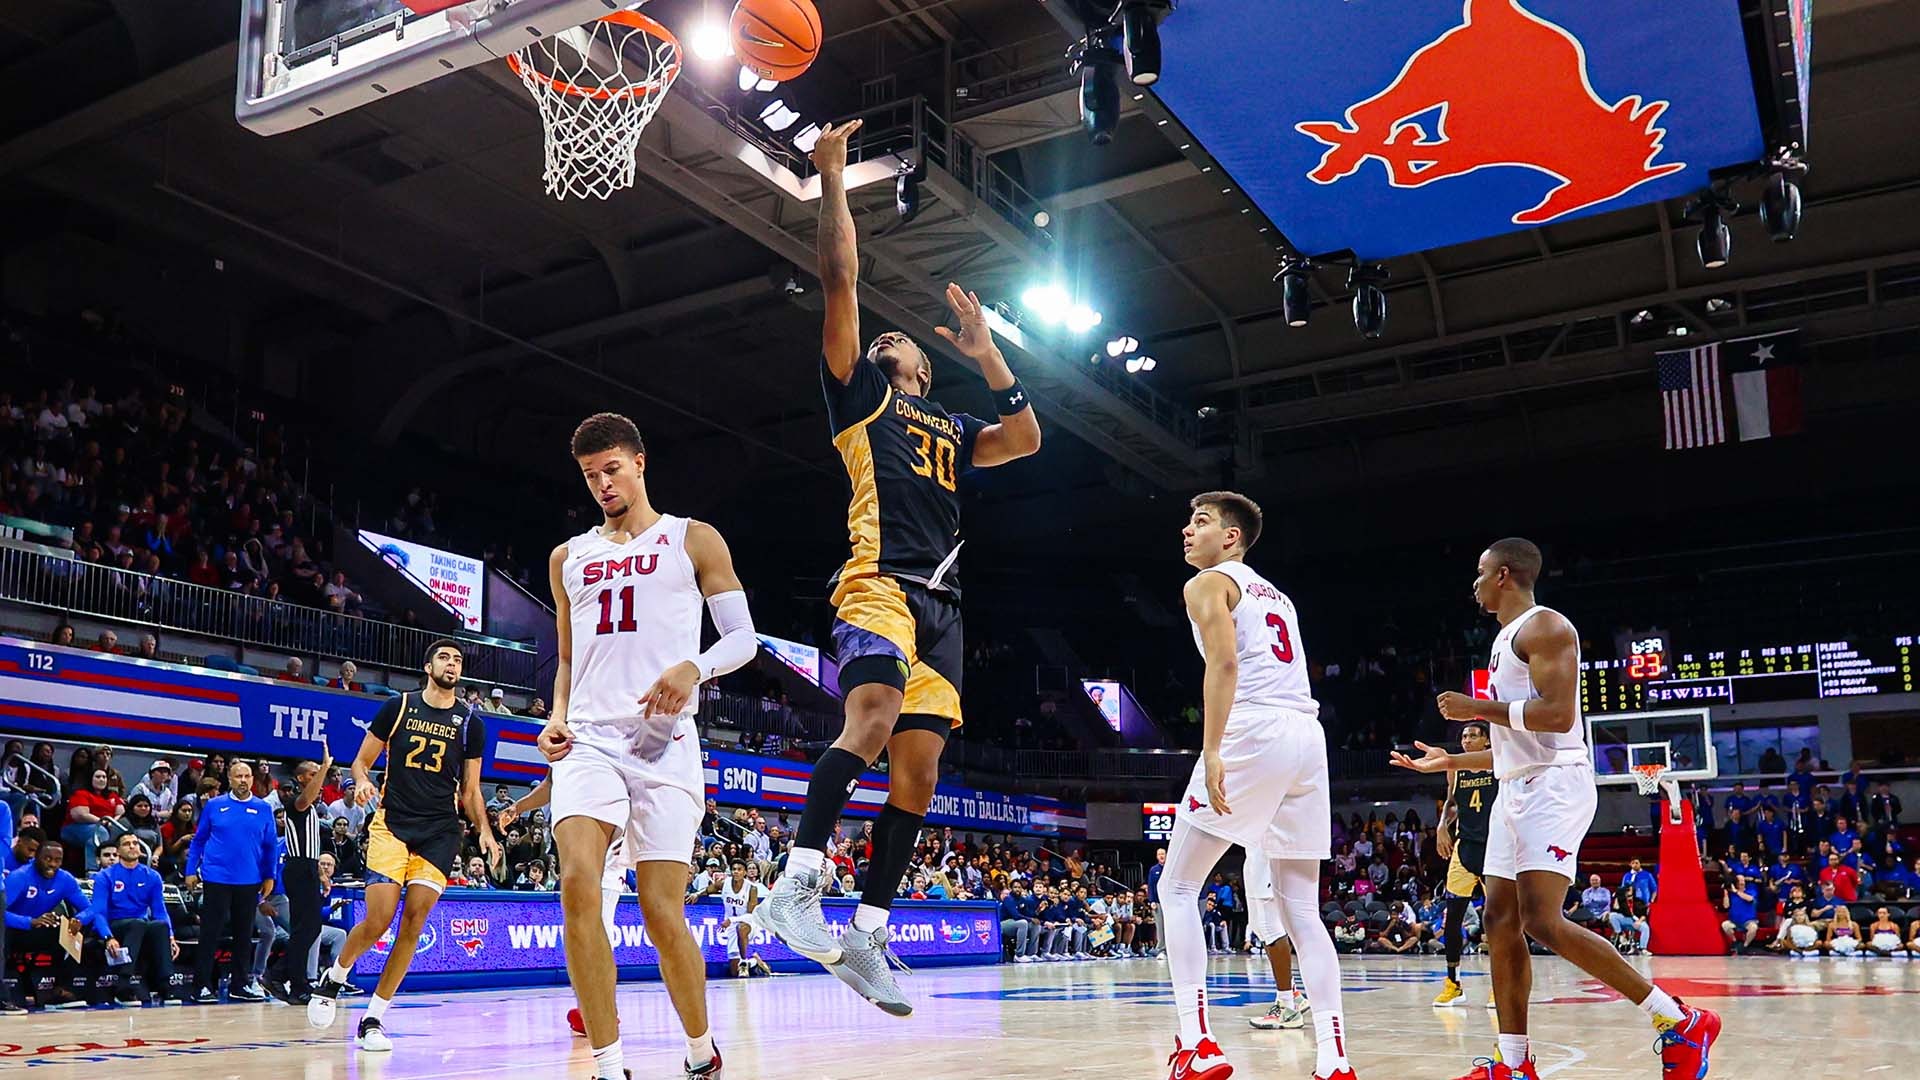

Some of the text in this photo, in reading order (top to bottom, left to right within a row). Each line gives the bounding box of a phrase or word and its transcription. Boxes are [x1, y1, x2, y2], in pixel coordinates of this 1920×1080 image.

[906, 425, 957, 493] 30
[430, 554, 476, 575] TAKING CARE
[430, 566, 458, 581] OF KIDS
[583, 553, 659, 587] SMU
[429, 578, 471, 597] ON AND OFF
[596, 585, 637, 635] 11
[1265, 612, 1294, 664] 3
[1631, 638, 1663, 654] 6:39
[1820, 636, 1912, 652] PLAYER PTS
[1901, 646, 1909, 655] 0
[27, 653, 53, 671] 112
[1629, 653, 1661, 678] 23
[1902, 664, 1910, 673] 0
[1904, 673, 1911, 682] 0
[1648, 685, 1729, 700] SEWELL
[1904, 683, 1912, 691] 0
[269, 704, 329, 742] THE
[405, 718, 457, 740] COMMERCE
[405, 735, 447, 773] 23
[701, 751, 709, 762] 13
[723, 767, 757, 794] SMU
[1459, 776, 1492, 789] COMMERCE
[926, 795, 959, 817] COME
[962, 798, 976, 818] TO
[1469, 789, 1482, 813] 4
[1149, 815, 1172, 830] 23
[726, 896, 744, 907] SMU
[731, 906, 737, 916] 1
[451, 918, 489, 936] SMU
